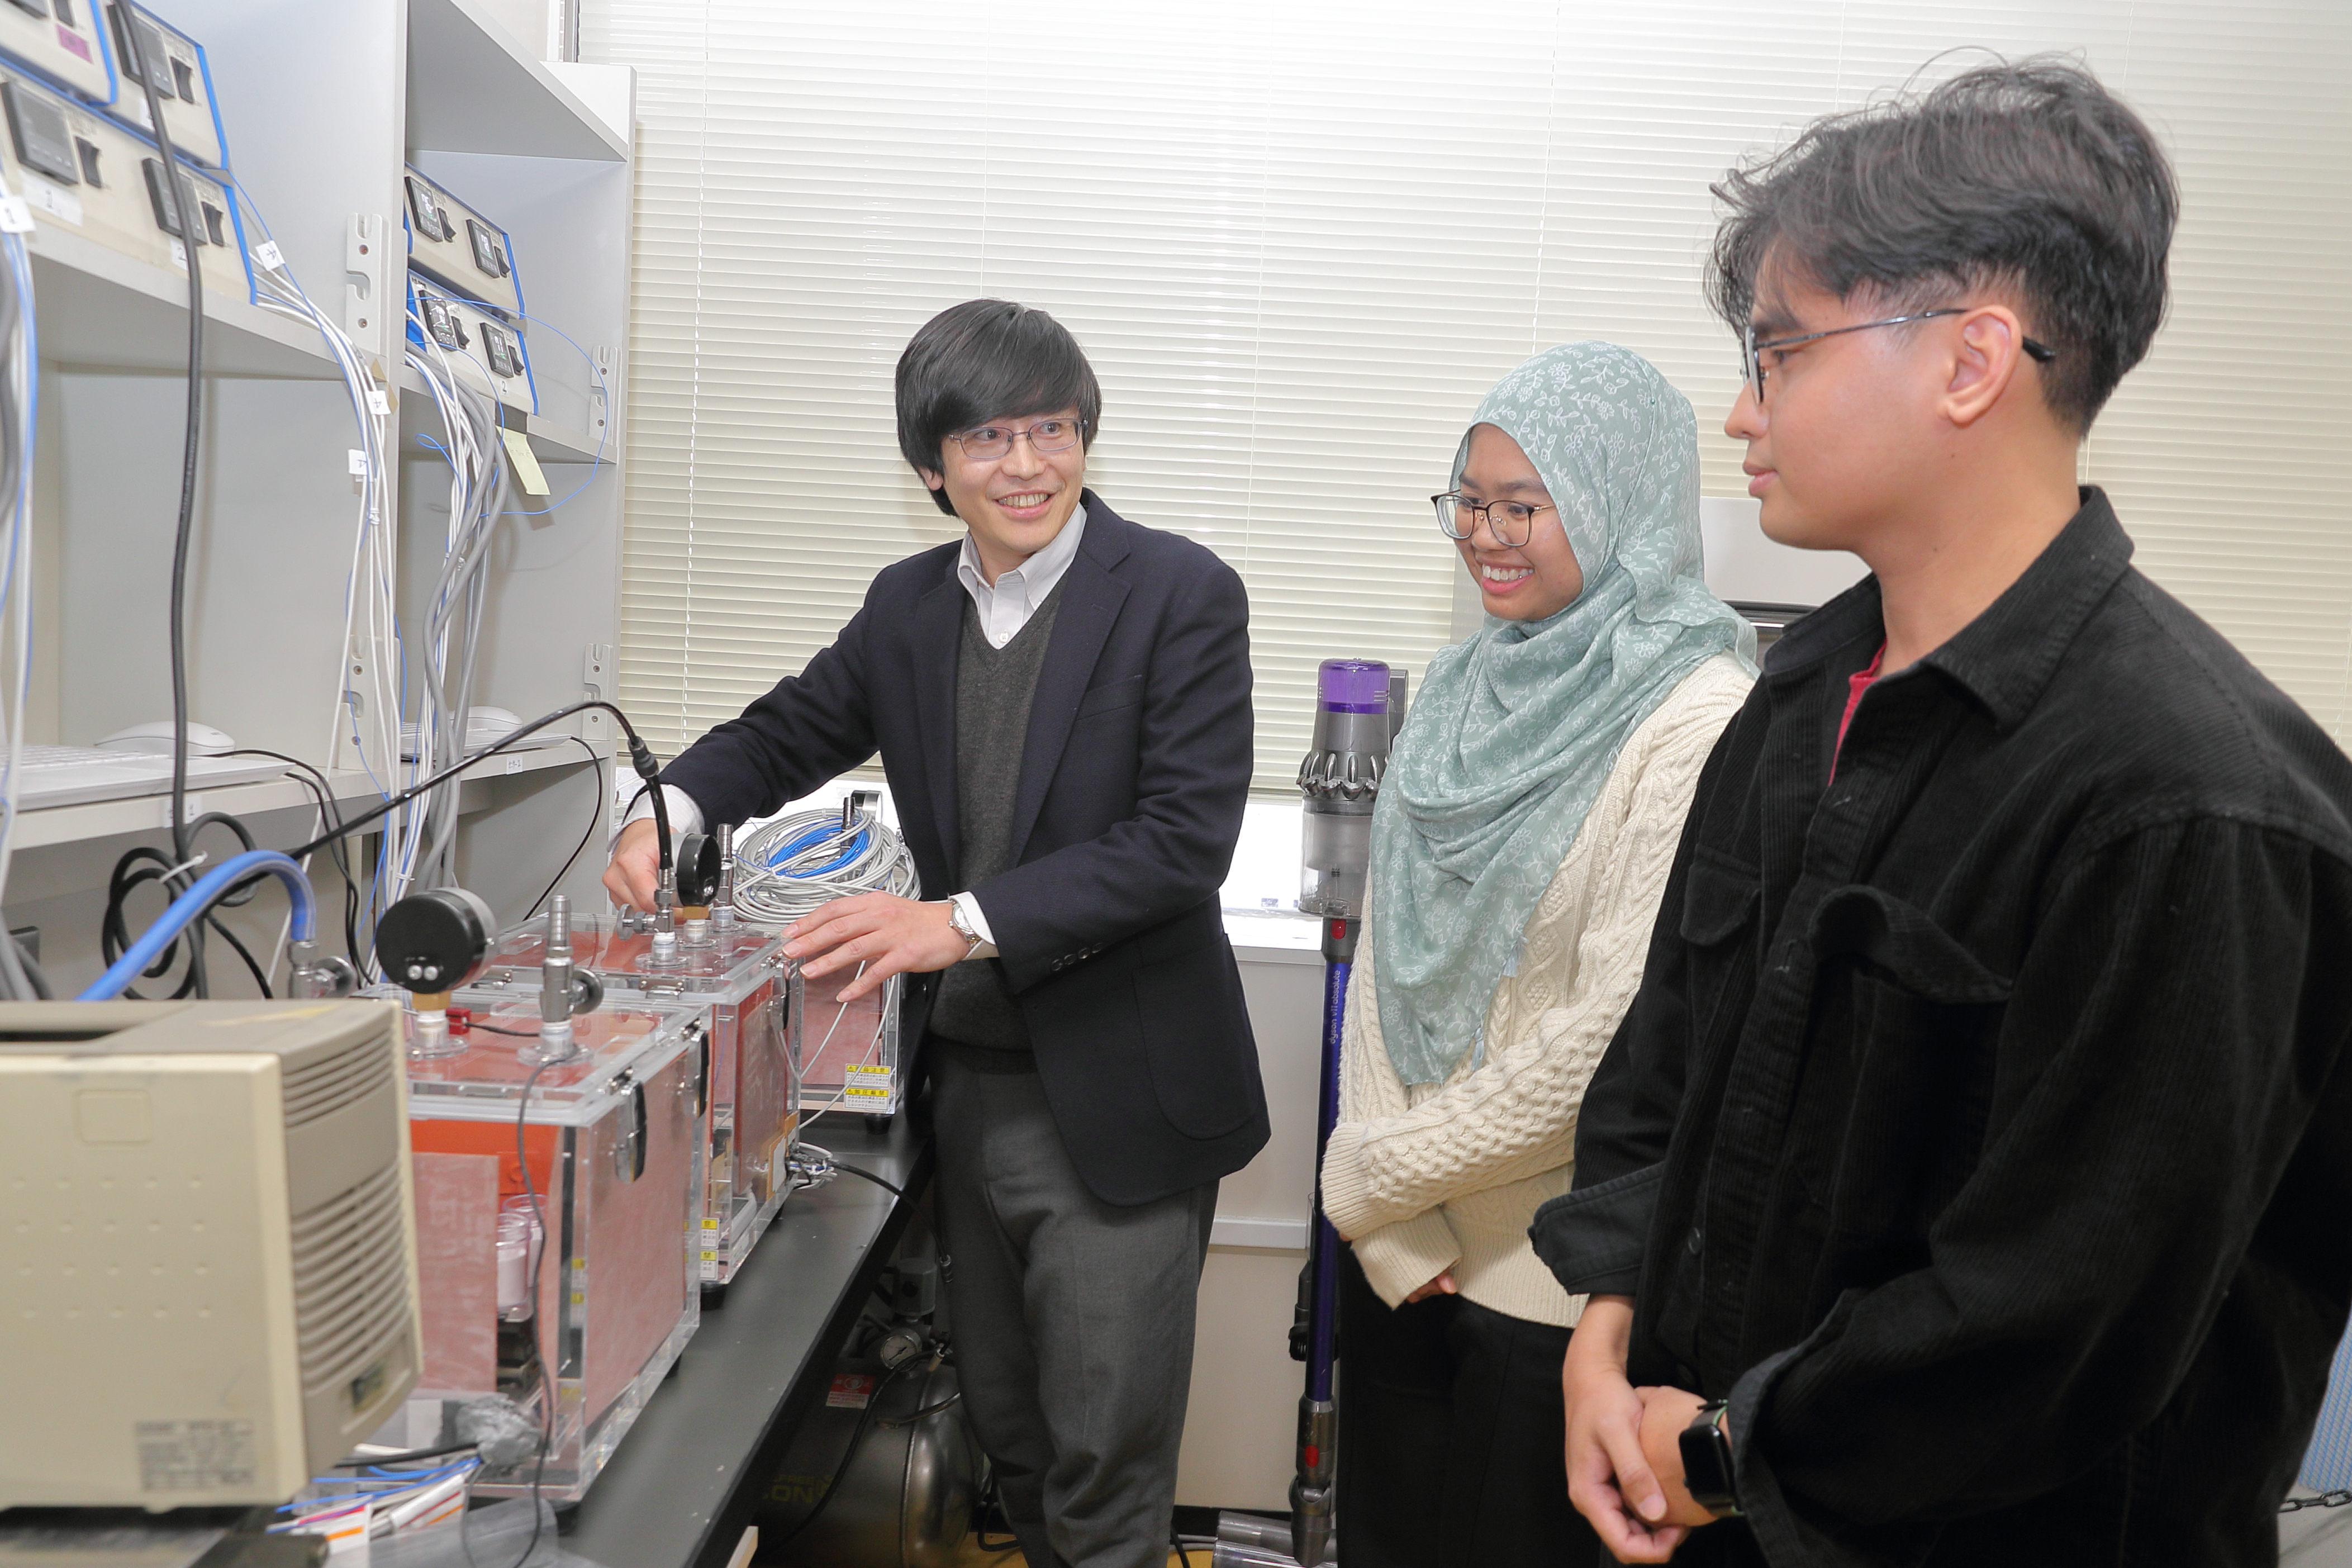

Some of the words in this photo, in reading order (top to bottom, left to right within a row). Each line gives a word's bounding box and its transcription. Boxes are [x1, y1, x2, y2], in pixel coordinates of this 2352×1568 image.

[1331, 970, 1341, 1004] absolute
[1328, 1019, 1338, 1044] dyson
[762, 1484, 814, 1504] ON
